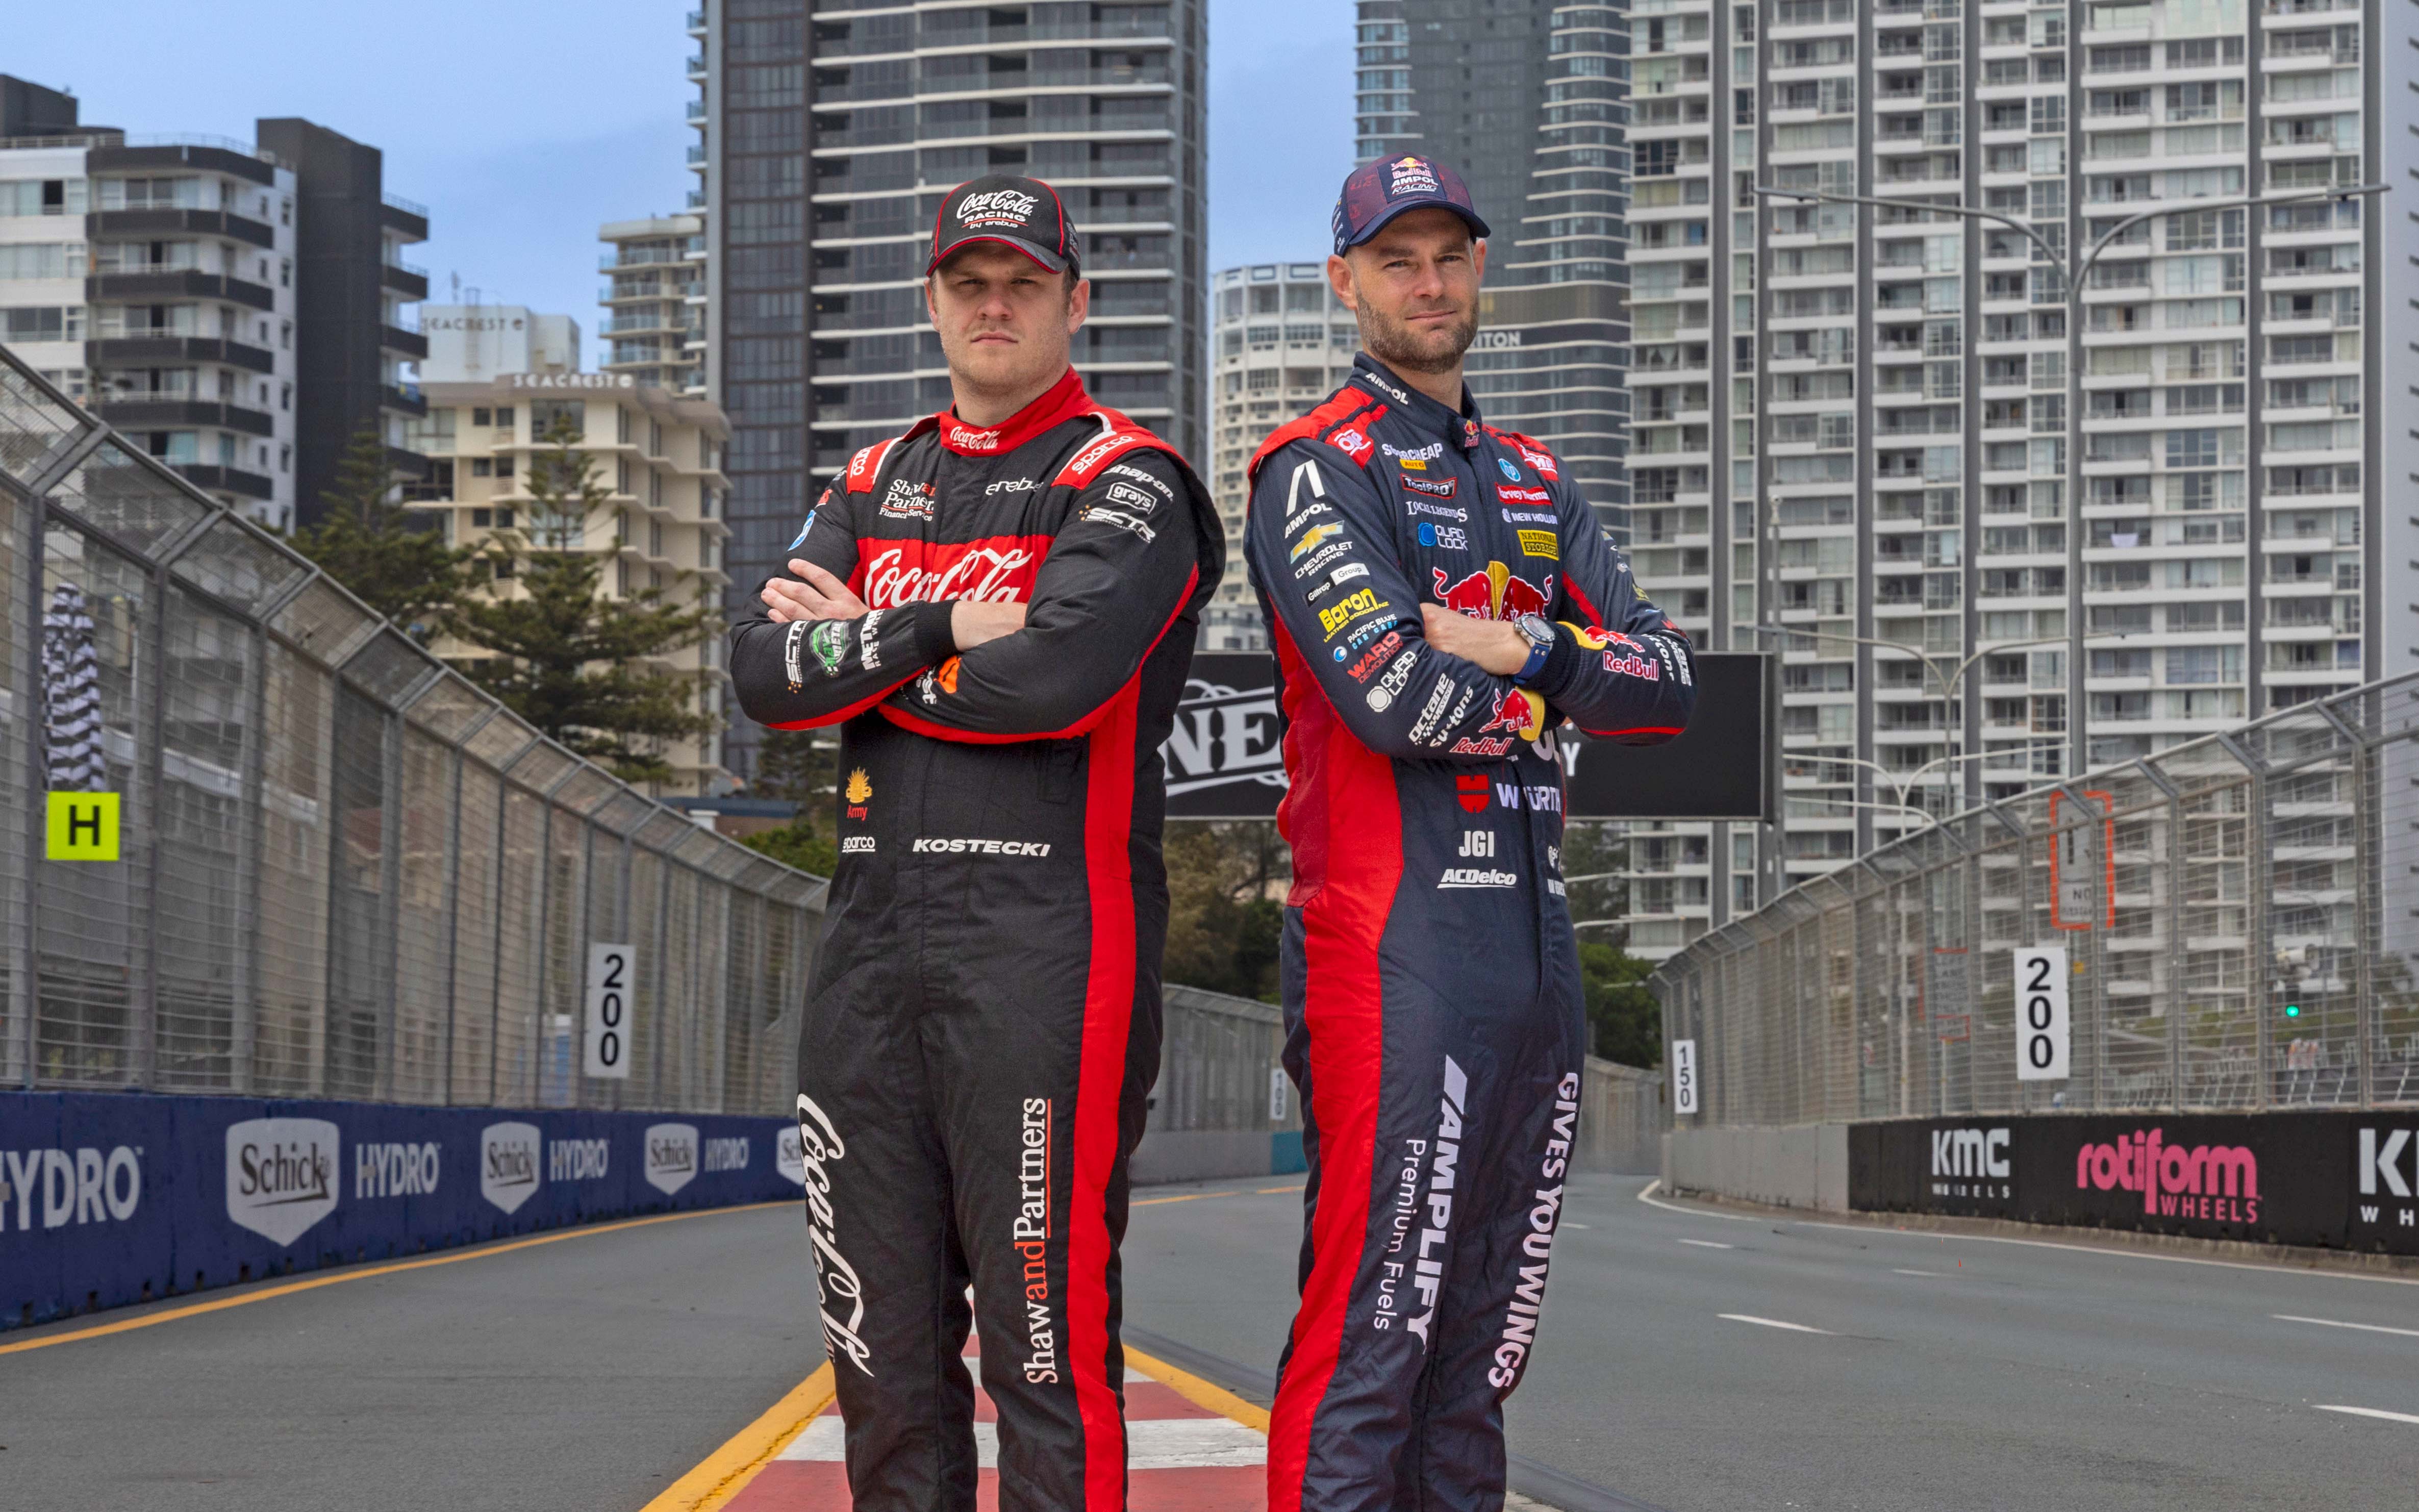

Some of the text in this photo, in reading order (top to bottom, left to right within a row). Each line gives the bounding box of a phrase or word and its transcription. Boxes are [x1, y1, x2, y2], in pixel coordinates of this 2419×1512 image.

[1392, 176, 1439, 188] AMPOL
[1392, 184, 1437, 194] RACING
[964, 212, 1026, 223] RACING
[1470, 332, 1520, 348] ITON
[513, 374, 614, 388] SEACREST
[1366, 372, 1408, 405] AMPOL
[853, 445, 875, 476] arco
[1071, 435, 1134, 475] sparco
[986, 477, 1044, 495] erebs
[1114, 487, 1152, 508] grays
[1523, 488, 1550, 500] Norma
[1285, 503, 1332, 539] AMPOL
[1405, 501, 1468, 522] LOCAL LEGENDS
[1511, 513, 1558, 525] NEW HOLLAN
[1434, 525, 1466, 540] QUAD
[1437, 536, 1469, 551] LOCK
[1521, 532, 1556, 543] NATIONAL
[1295, 541, 1353, 579] CHEVROLET
[1308, 551, 1344, 576] RACING
[1338, 567, 1363, 578] Group
[1318, 588, 1379, 633] Baron
[1323, 601, 1390, 643] LEATHER GOODS NZ
[1347, 614, 1397, 643] PACIFIC BLUE
[1352, 633, 1369, 650] CAR
[786, 620, 807, 683] SCTR
[1347, 631, 1400, 678] WARD
[1357, 640, 1403, 684] DEMOLITION
[1380, 651, 1416, 688] QUAD
[1408, 673, 1450, 743] octane
[1439, 680, 1455, 711] EVENTS
[68, 804, 100, 846] H
[847, 804, 867, 821] Army
[842, 836, 876, 852] sparco
[913, 839, 1051, 857] KOSTECKI
[1458, 830, 1495, 858] JGI
[1440, 869, 1517, 886] ACDelco
[599, 953, 625, 1066] 200
[2027, 957, 2053, 1069] 200
[1678, 1046, 1691, 1107] 150
[240, 1142, 329, 1199] Schick
[356, 1142, 439, 1199] HYDRO
[488, 1139, 609, 1182] Schick HYDRO
[650, 1138, 691, 1170] Schick
[704, 1138, 748, 1172] HYDRO
[2359, 1128, 2419, 1197] K
[2077, 1127, 2257, 1215] rotiform
[1407, 1097, 1462, 1352] AMPLIFY
[2160, 1195, 2258, 1224] WHEELS
[797, 1094, 874, 1377] Coca-Cl
[1374, 1138, 1426, 1330] Premium Fuels
[1488, 1072, 1578, 1388] GIVES YOU WINGS
